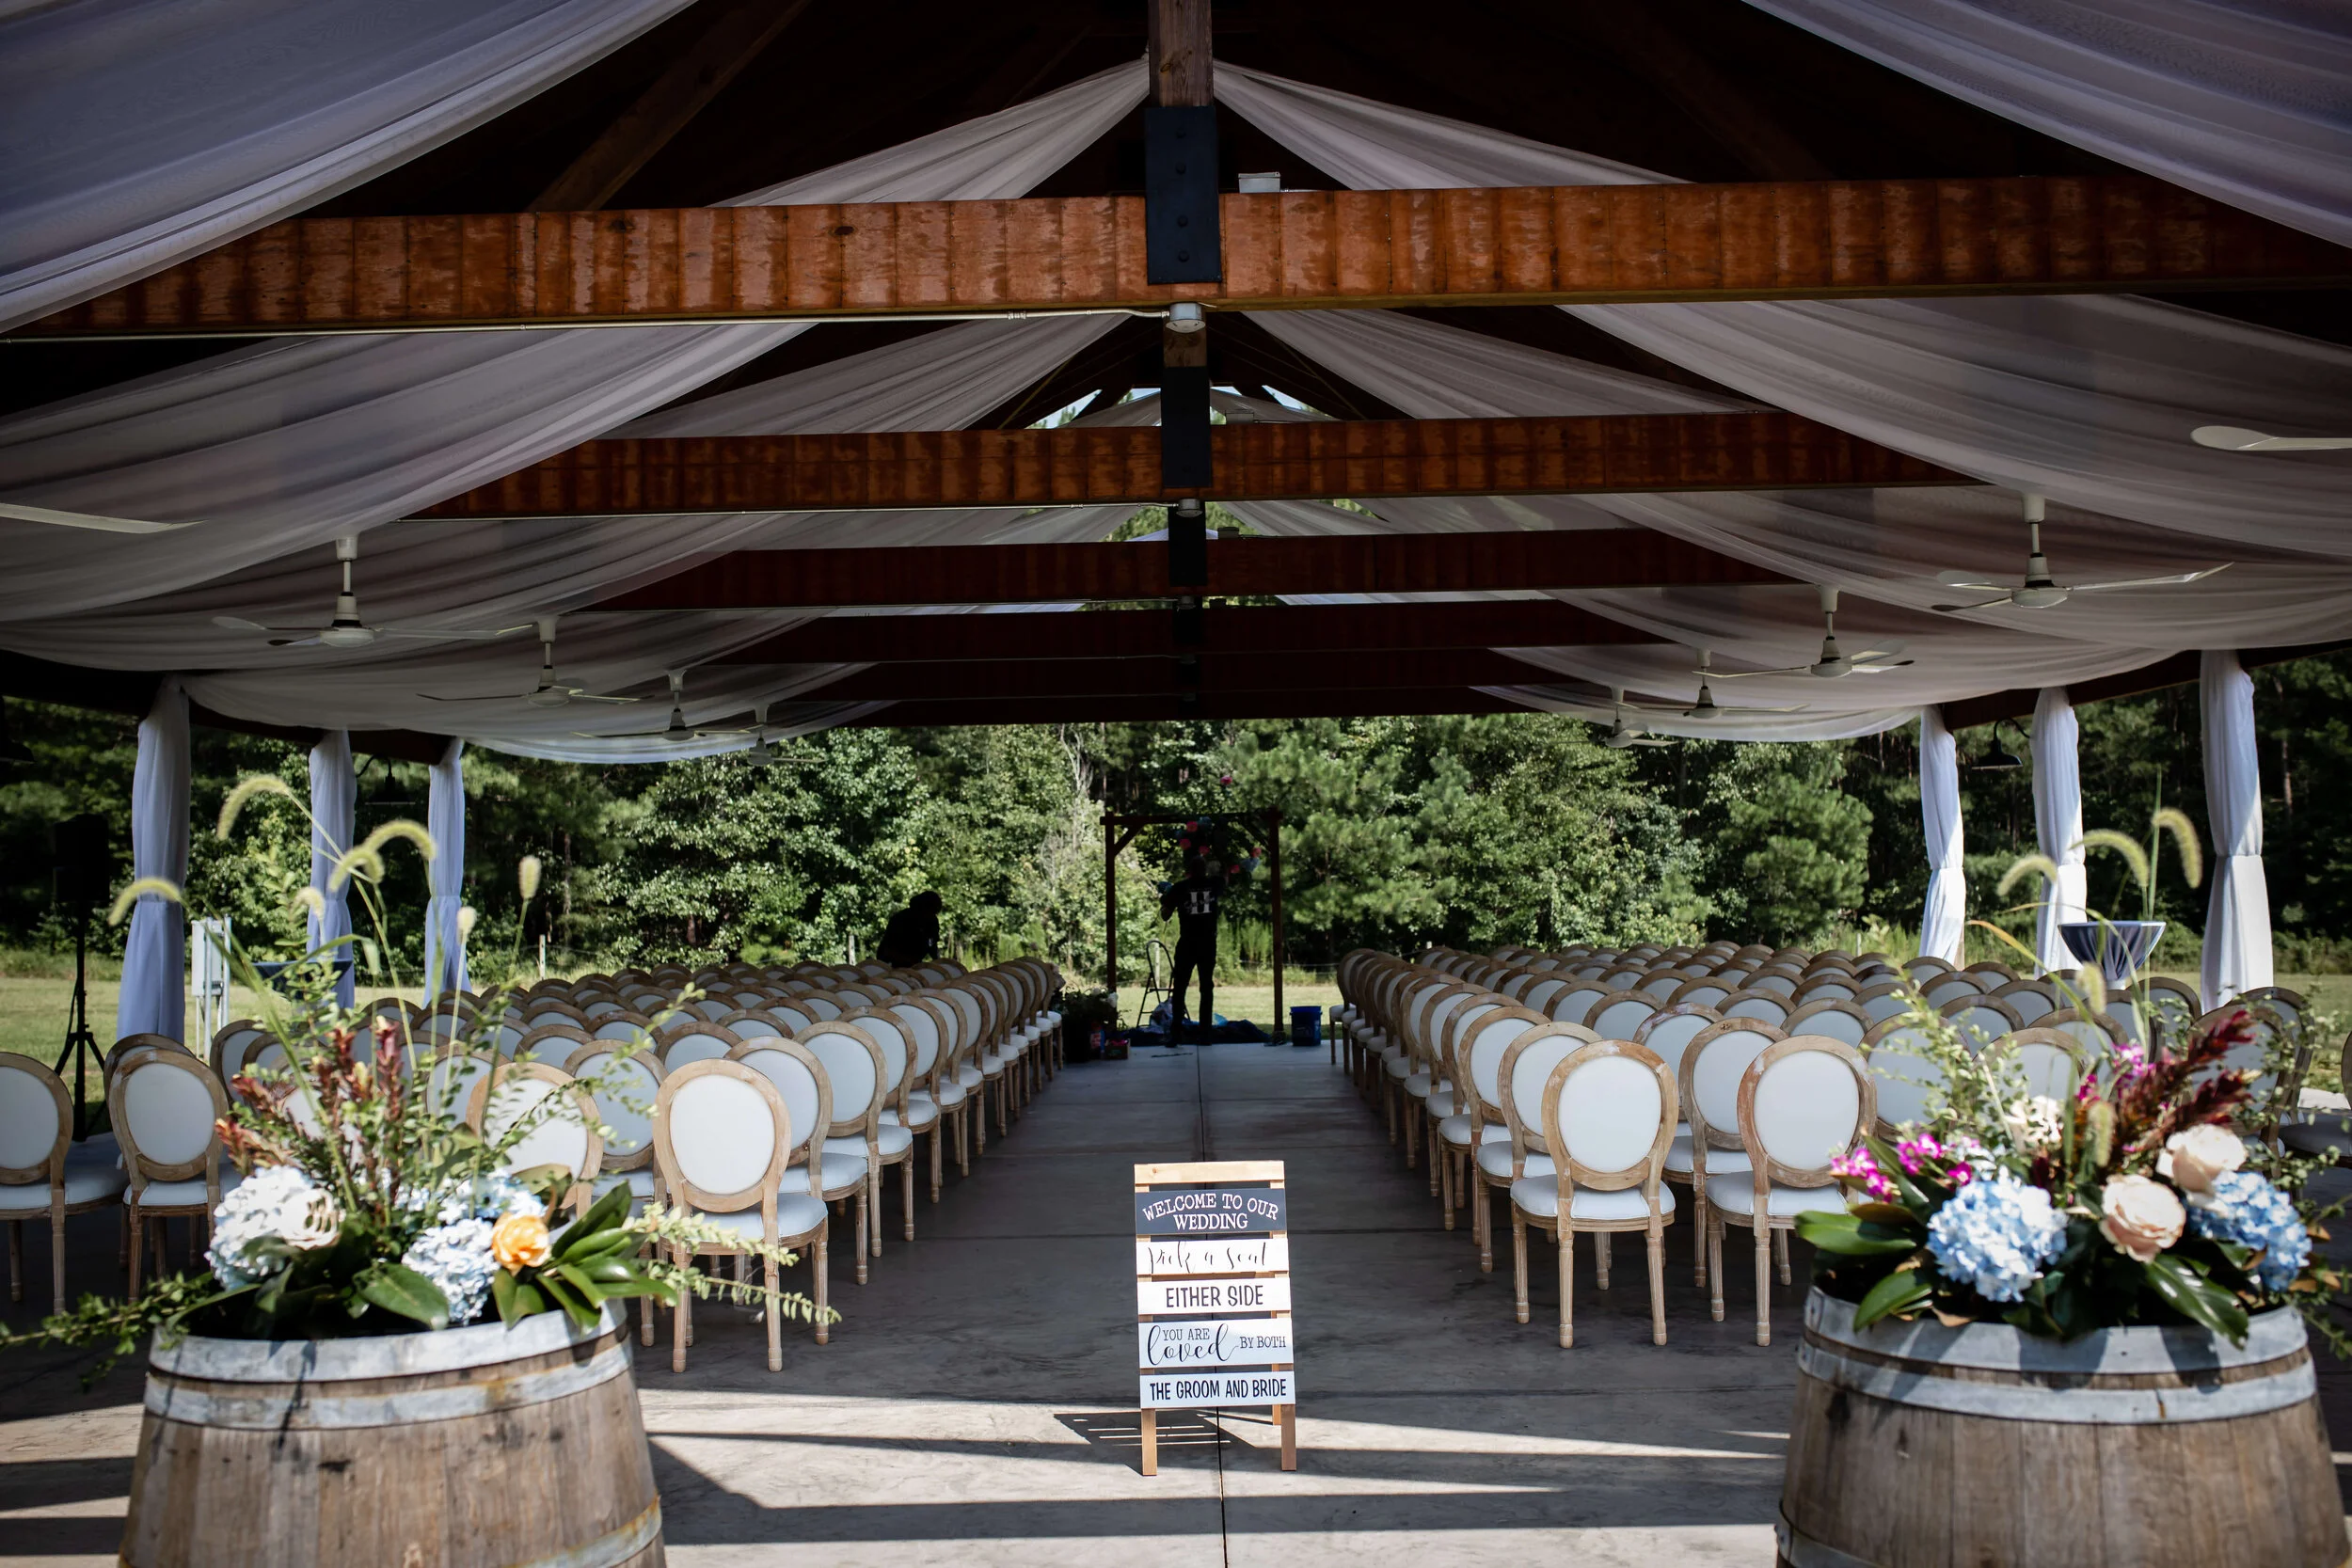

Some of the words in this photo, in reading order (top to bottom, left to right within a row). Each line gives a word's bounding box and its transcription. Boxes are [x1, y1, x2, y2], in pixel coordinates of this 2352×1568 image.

[1142, 1193, 1216, 1221] WELCOME
[1222, 1194, 1243, 1210] TO
[1247, 1197, 1279, 1220] OUR
[1173, 1212, 1248, 1230] WEDDING
[1166, 1285, 1222, 1308] EITHER
[1227, 1285, 1263, 1307] SIDE
[1147, 1323, 1239, 1366] loved
[1240, 1336, 1254, 1349] BY
[1257, 1336, 1286, 1349] BOTH
[1162, 1328, 1183, 1341] YOU
[1187, 1327, 1210, 1340] ARE
[1150, 1382, 1171, 1402] THE
[1176, 1380, 1220, 1399] GROOM
[1225, 1379, 1248, 1398] AND
[1252, 1378, 1287, 1398] BRIDE
